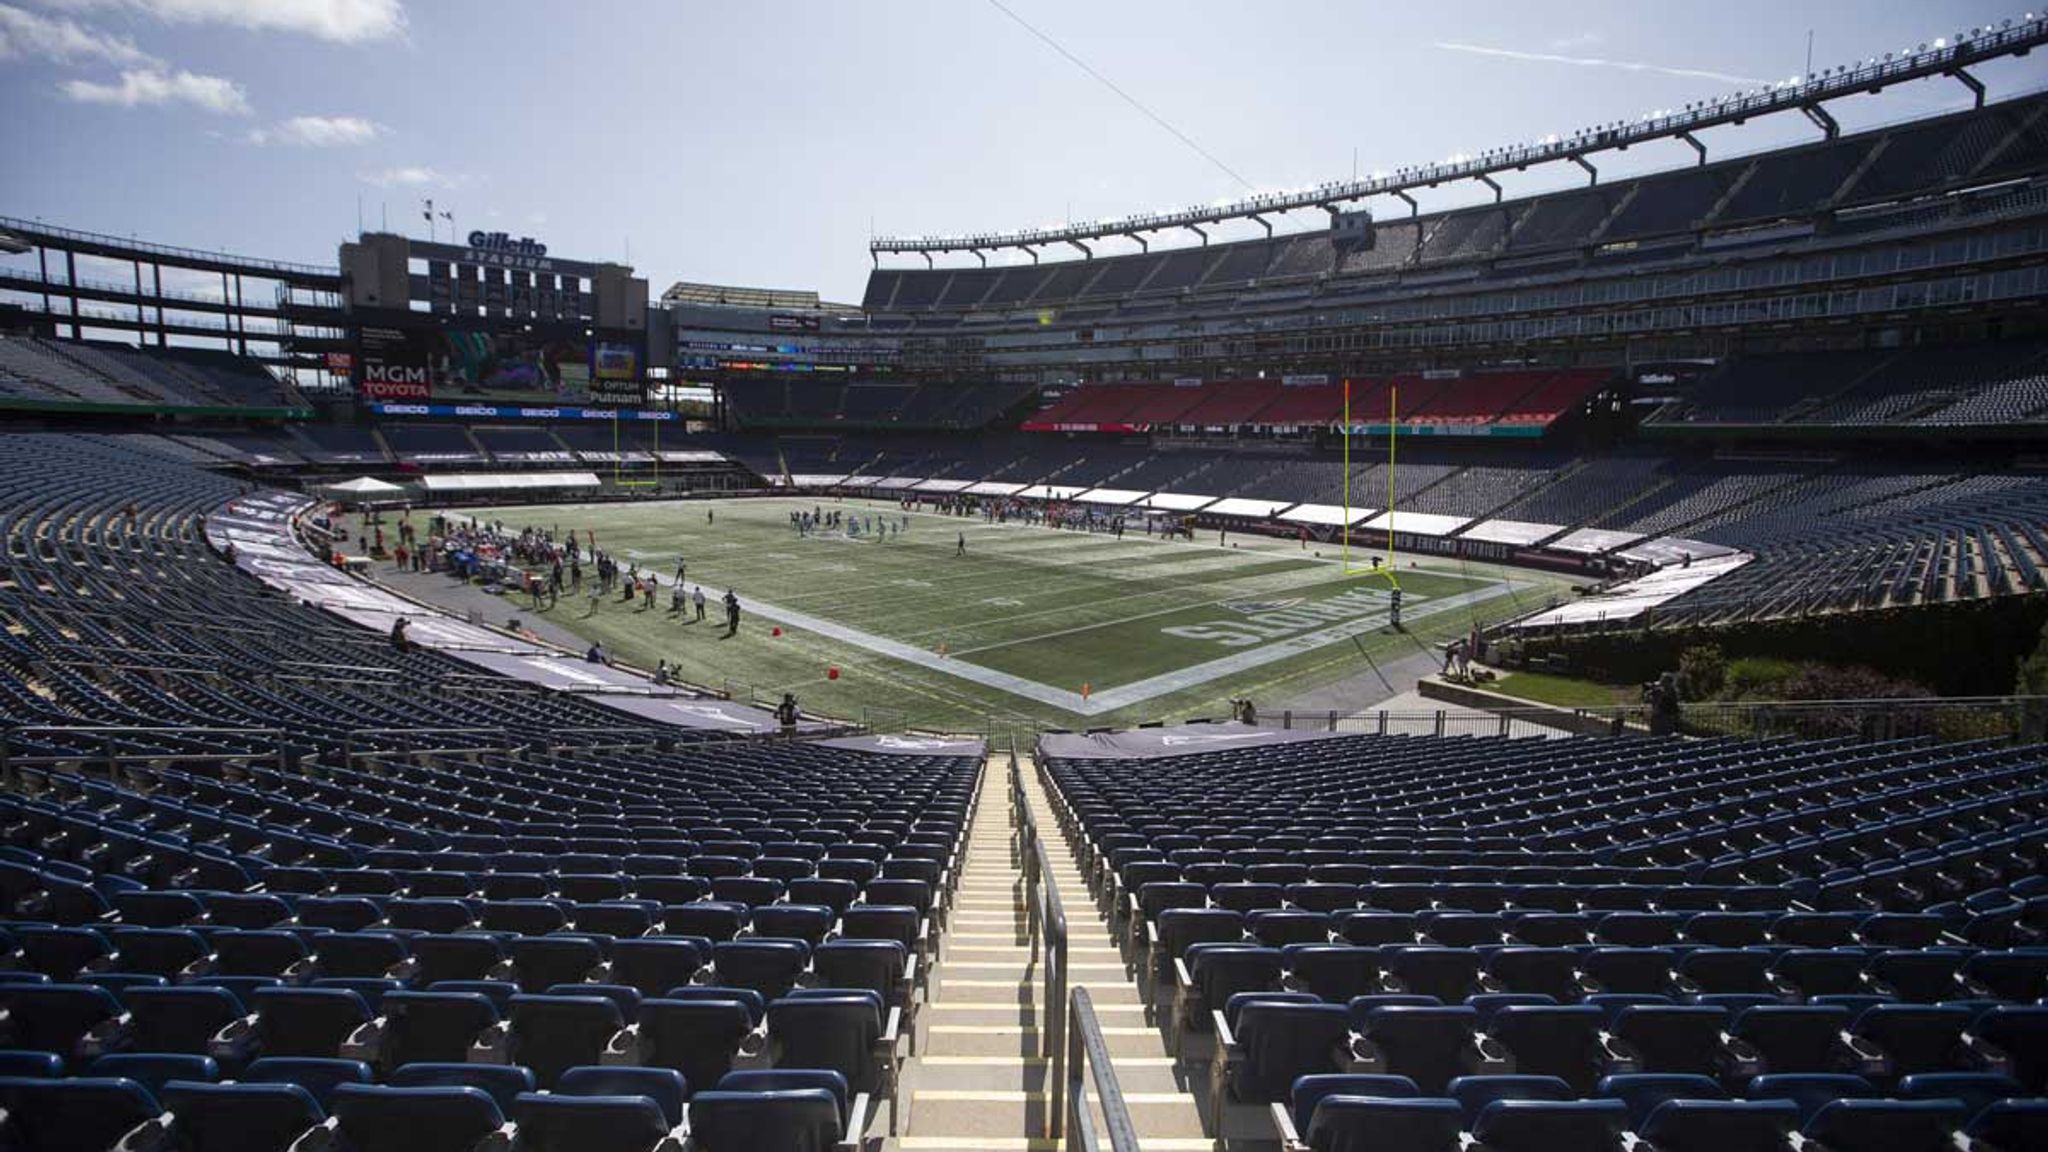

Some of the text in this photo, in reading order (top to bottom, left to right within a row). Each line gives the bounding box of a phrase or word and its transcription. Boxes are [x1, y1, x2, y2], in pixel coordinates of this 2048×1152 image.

[468, 230, 547, 256] Gillette
[464, 250, 552, 270] STADIUM
[366, 365, 425, 383] MGM
[363, 381, 428, 397] TOYOTA
[590, 391, 641, 404] Putnam
